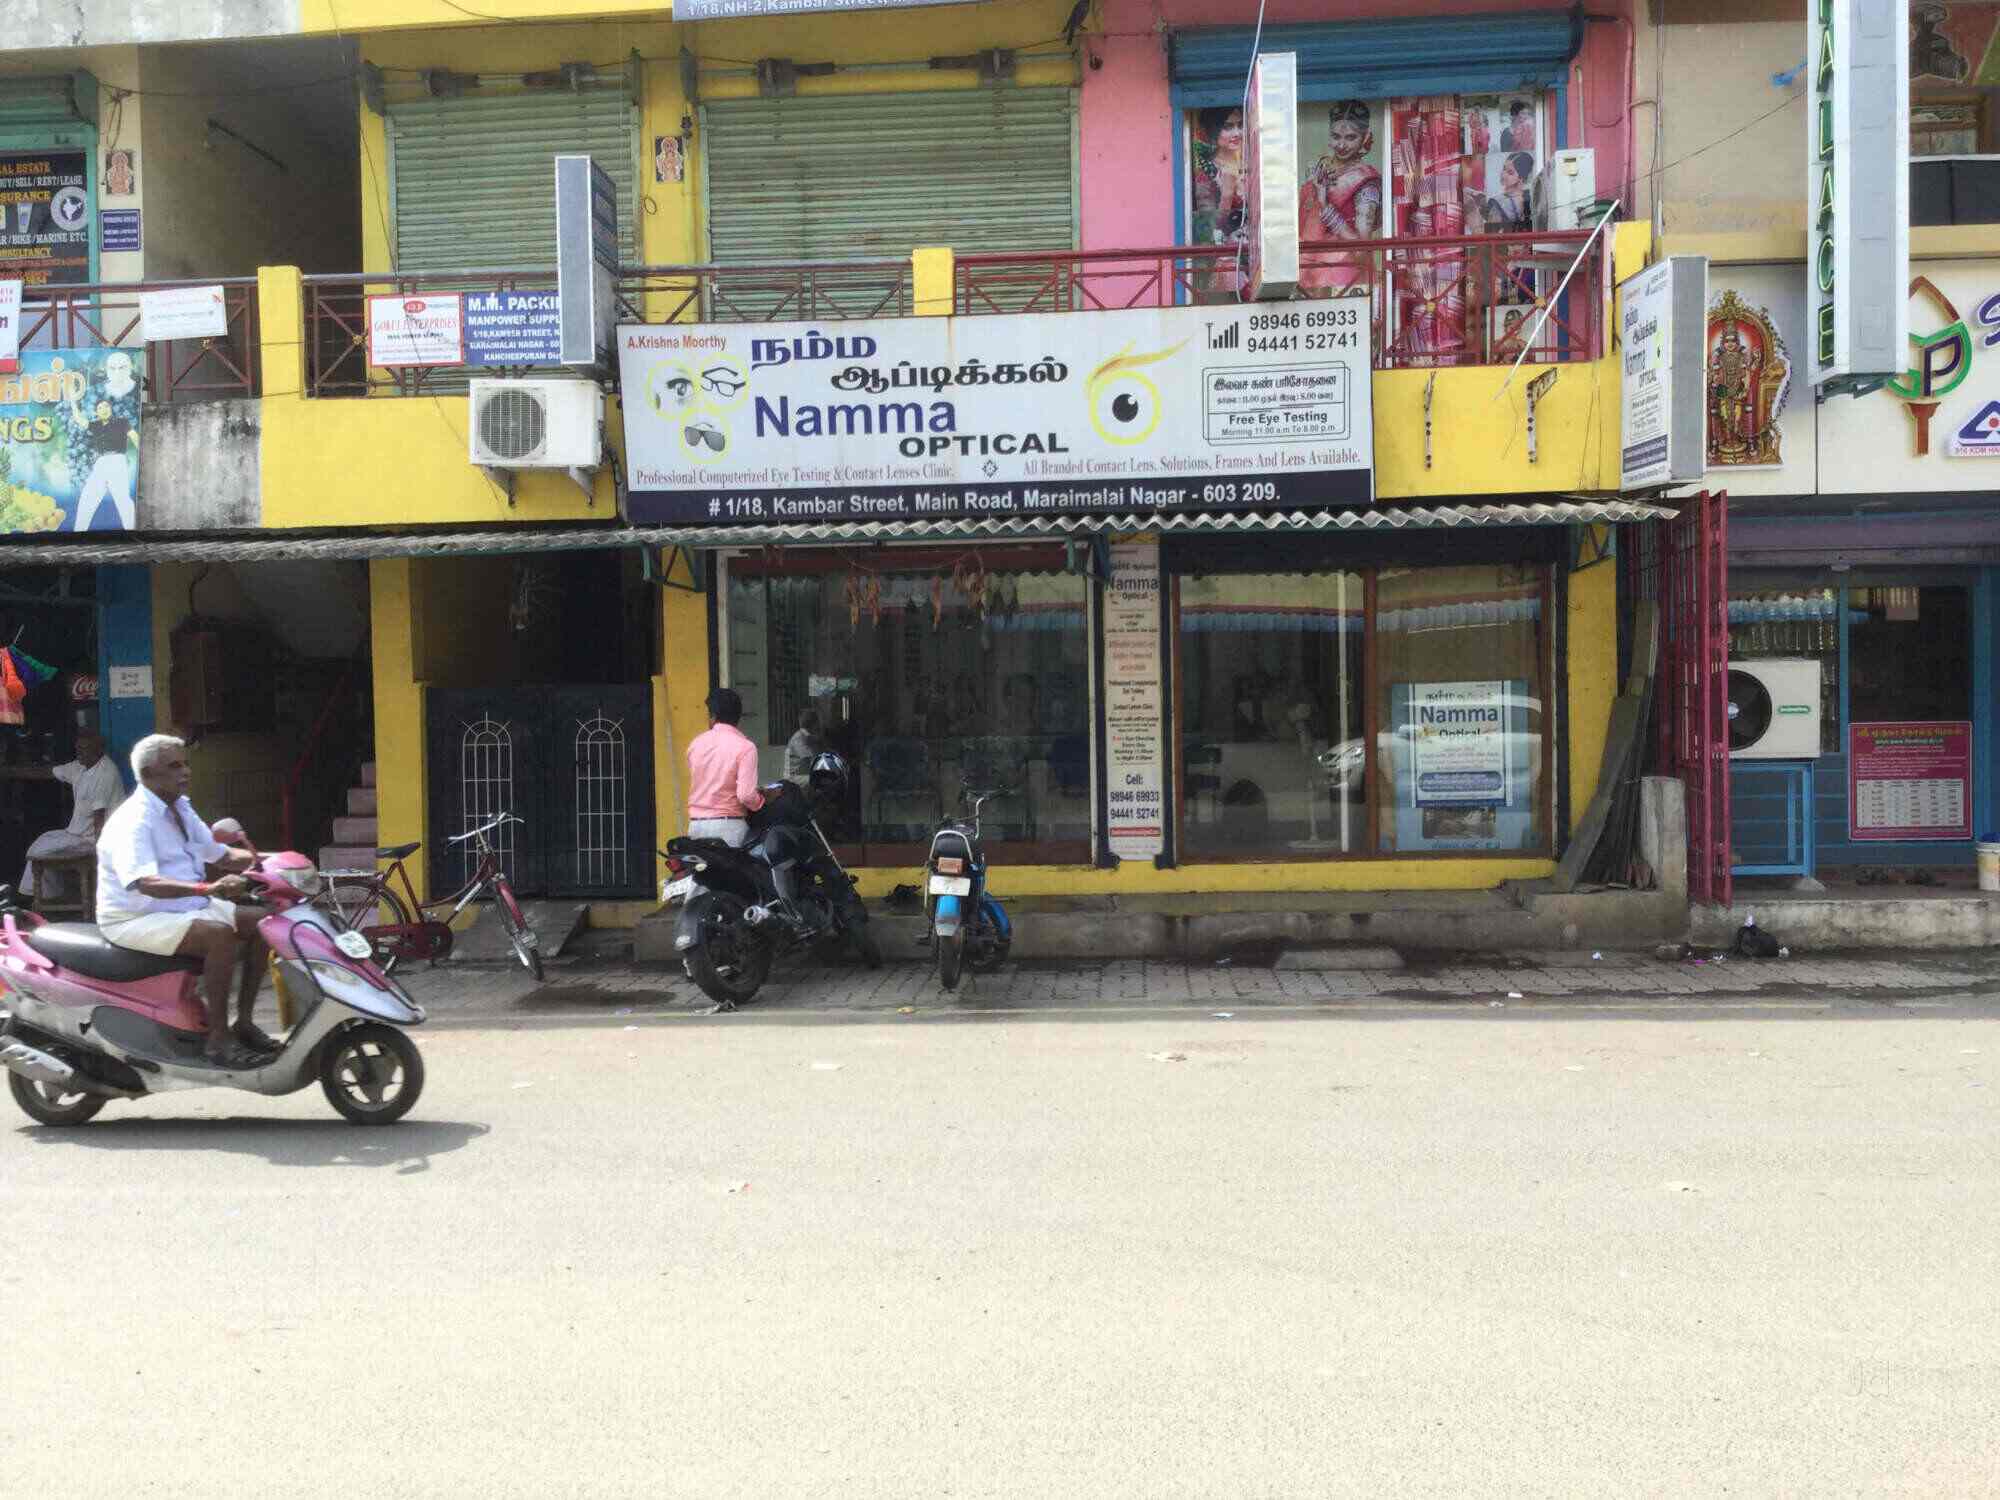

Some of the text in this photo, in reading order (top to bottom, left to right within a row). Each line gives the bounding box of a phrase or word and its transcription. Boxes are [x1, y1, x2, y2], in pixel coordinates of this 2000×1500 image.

[1816, 0, 1835, 367] ALACE
[1249, 310, 1357, 331] 98946 69933
[628, 334, 727, 351] A.Krishna Moorthy
[751, 330, 877, 371] நம்ம
[1247, 332, 1357, 353] 94441 52741
[831, 356, 1068, 394] ஆப்டிக்கல்
[754, 396, 956, 437] Namma
[1229, 411, 1328, 426] Free Eye Testing
[898, 433, 1069, 458] OPTICAL
[1024, 459, 1038, 475] All
[1041, 458, 1083, 475] Branded
[1086, 457, 1127, 474] Contact
[1216, 453, 1253, 469] Frames
[1254, 452, 1278, 467] And
[1281, 451, 1306, 467] Lens
[637, 469, 697, 485] Professional
[699, 465, 769, 489] Computerized
[771, 469, 790, 487] Eye
[792, 467, 831, 485] Testing
[887, 464, 920, 480] Lenses
[708, 498, 721, 516] #
[726, 497, 768, 518] 1/18,
[773, 495, 845, 515] Kambar
[850, 494, 909, 513] Street,
[915, 492, 958, 512] Main
[964, 491, 1018, 511] Road,
[1023, 488, 1124, 508] Maraimalai
[1130, 487, 1186, 508] Nagar
[1203, 484, 1237, 502] 603
[1242, 483, 1281, 501] 209.
[1420, 706, 1498, 724] Namma
[1125, 774, 1144, 785] Cell:
[1110, 791, 1134, 803] 98946
[1110, 808, 1160, 820] 94441 52741
